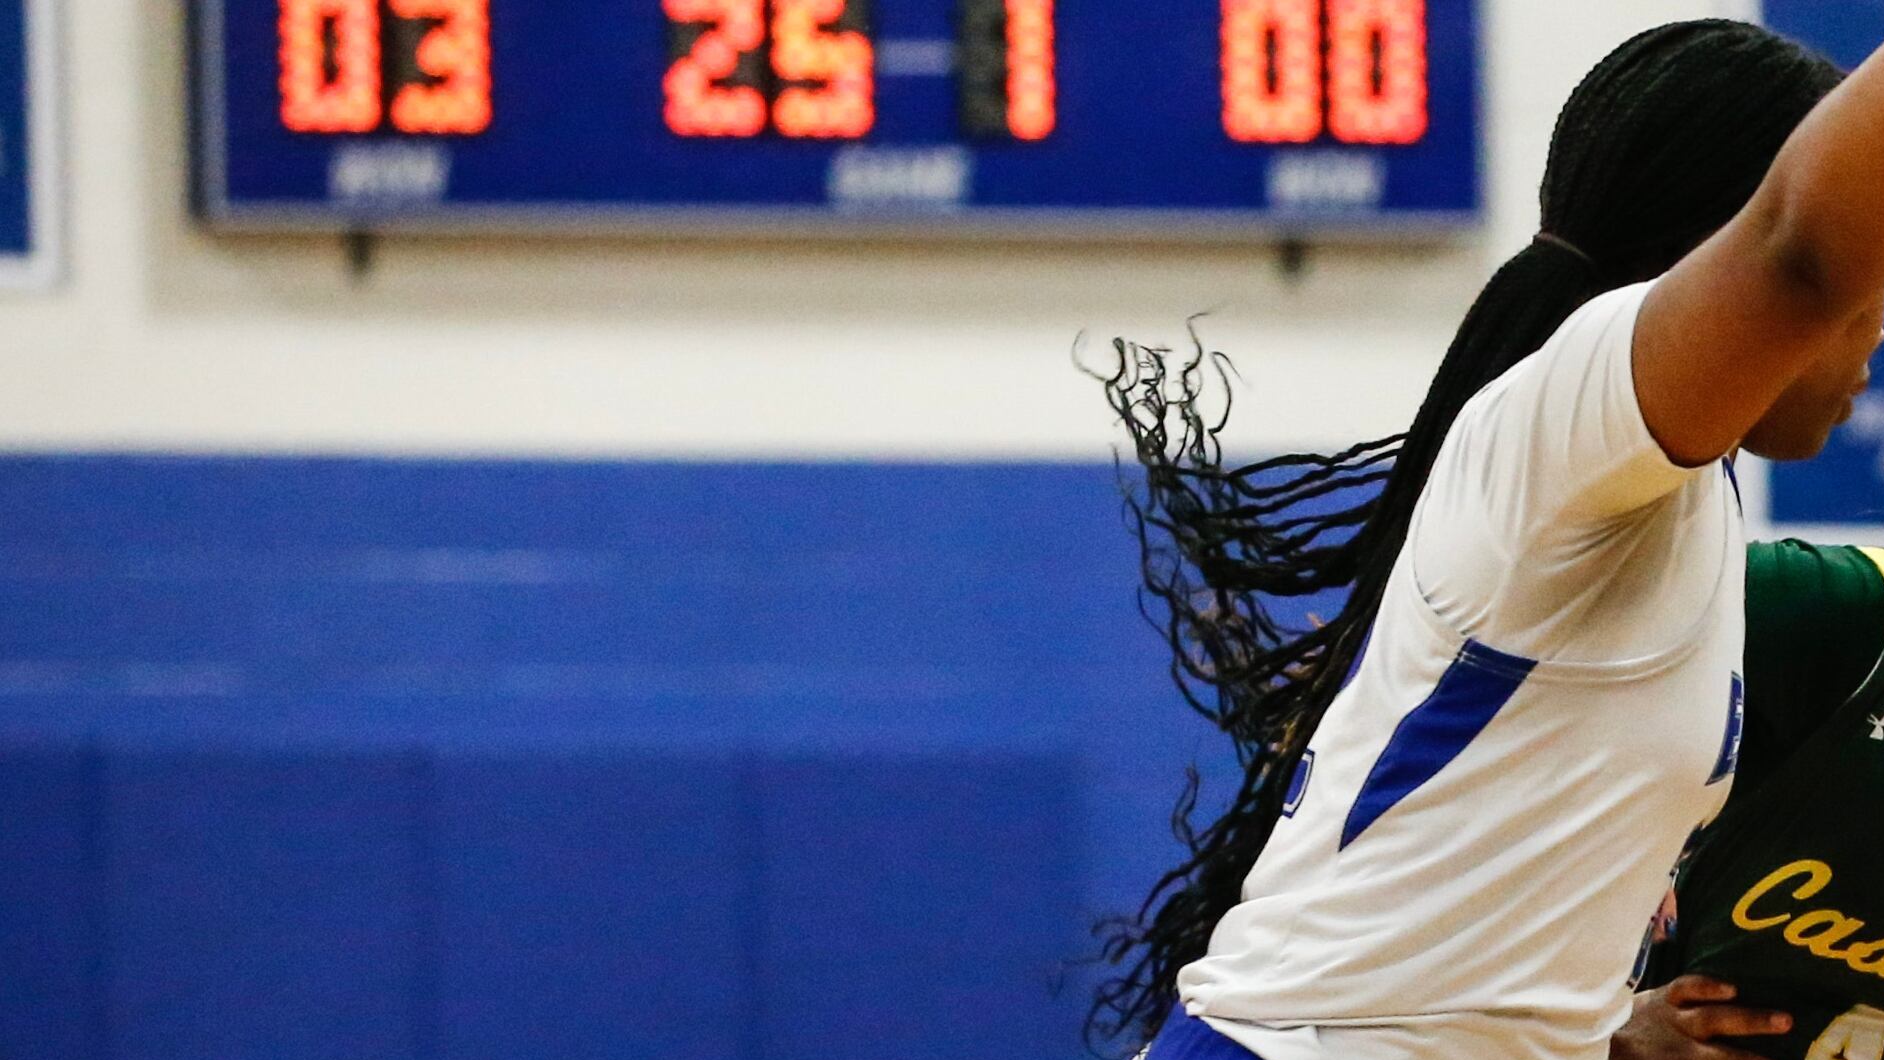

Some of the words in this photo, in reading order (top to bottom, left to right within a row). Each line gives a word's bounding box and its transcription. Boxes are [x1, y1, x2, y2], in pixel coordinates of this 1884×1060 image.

[279, 0, 492, 134] 03
[662, 0, 875, 138] 25
[1220, 0, 1428, 144] 00
